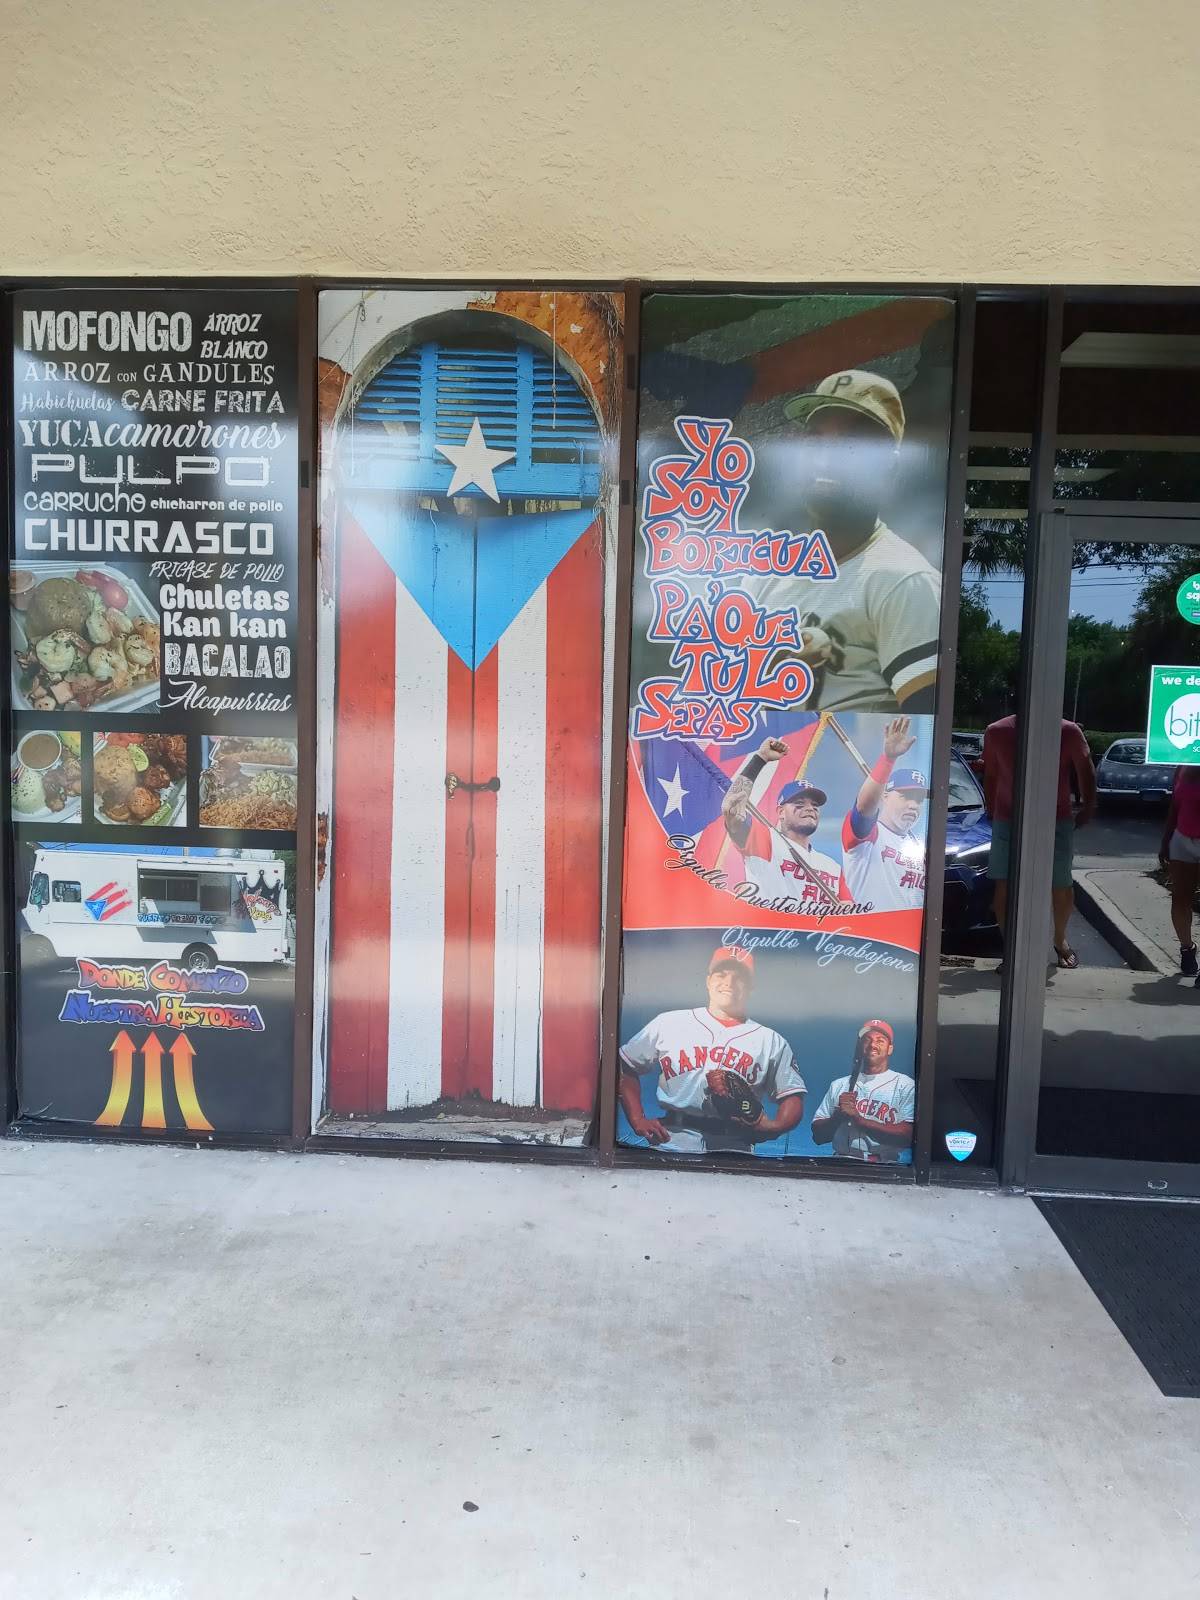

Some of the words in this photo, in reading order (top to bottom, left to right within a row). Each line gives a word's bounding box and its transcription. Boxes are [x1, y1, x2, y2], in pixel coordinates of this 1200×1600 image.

[22, 310, 192, 352] MOFONGO
[203, 313, 263, 336] ARROZ
[200, 340, 268, 360] BLANCO
[23, 362, 111, 384] ARROZ
[117, 372, 137, 383] CON
[143, 361, 275, 386] GANDULES
[831, 375, 852, 394] P
[19, 389, 115, 412] Habichuelas
[120, 389, 207, 412] CARNE
[214, 390, 285, 413] FRITA
[18, 419, 106, 448] YUCA
[104, 420, 286, 449] camarones
[31, 452, 270, 487] PULPO
[150, 498, 225, 511] chicharron
[228, 499, 246, 511] de
[249, 499, 283, 513] pollo
[24, 518, 274, 555] CHURRASCO
[148, 559, 217, 582] FRICASE
[219, 562, 242, 580] DE
[243, 562, 285, 582] POLLO
[159, 583, 290, 611] Chuletas
[163, 612, 221, 637] Kan
[229, 612, 287, 638] kan
[164, 642, 291, 679] BACALAO
[1161, 676, 1182, 686] we
[156, 678, 292, 716] Alcapurrias
[664, 834, 728, 891] Orgullo
[721, 925, 800, 961] Orgullo
[807, 926, 915, 974] Vegabajeno
[77, 958, 148, 991] DONDE
[149, 960, 249, 994] COMENZO
[59, 990, 156, 1026] NUESTRA
[155, 993, 265, 1031] HISTORIA
[659, 1046, 763, 1085] RANGERS
[855, 1098, 899, 1125] GERS
